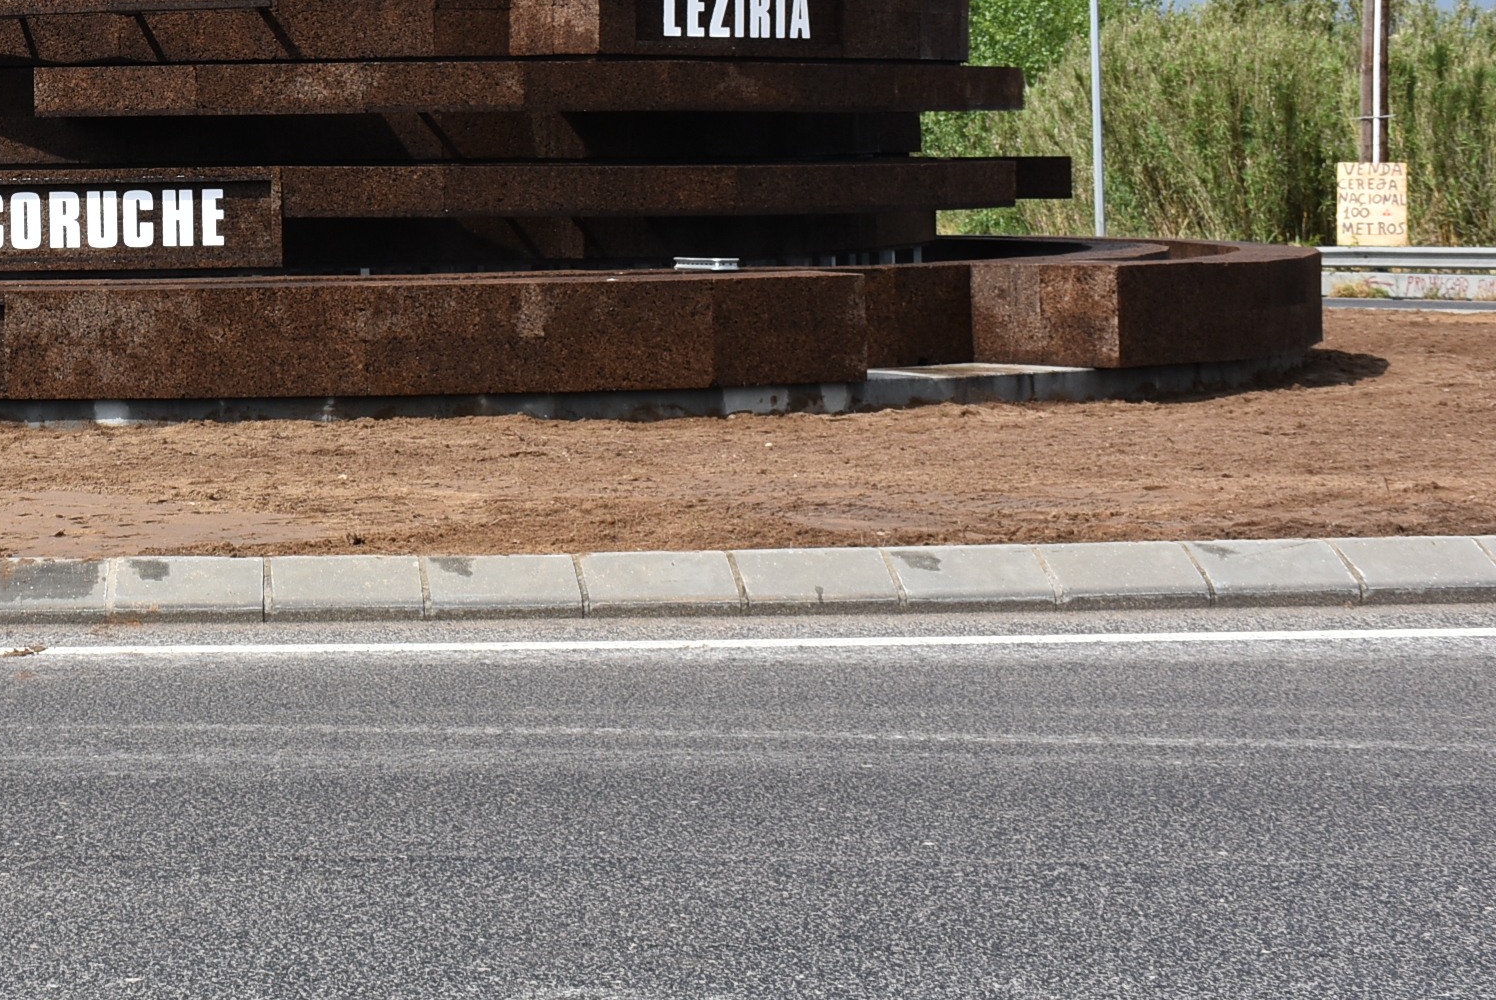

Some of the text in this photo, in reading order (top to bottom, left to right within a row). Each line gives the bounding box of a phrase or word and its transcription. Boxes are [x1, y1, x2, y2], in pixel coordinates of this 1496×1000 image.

[1343, 163, 1402, 176] VENDA
[1337, 178, 1398, 190] CEREJA
[1343, 206, 1370, 219] 100
[1342, 222, 1405, 236] METROS
